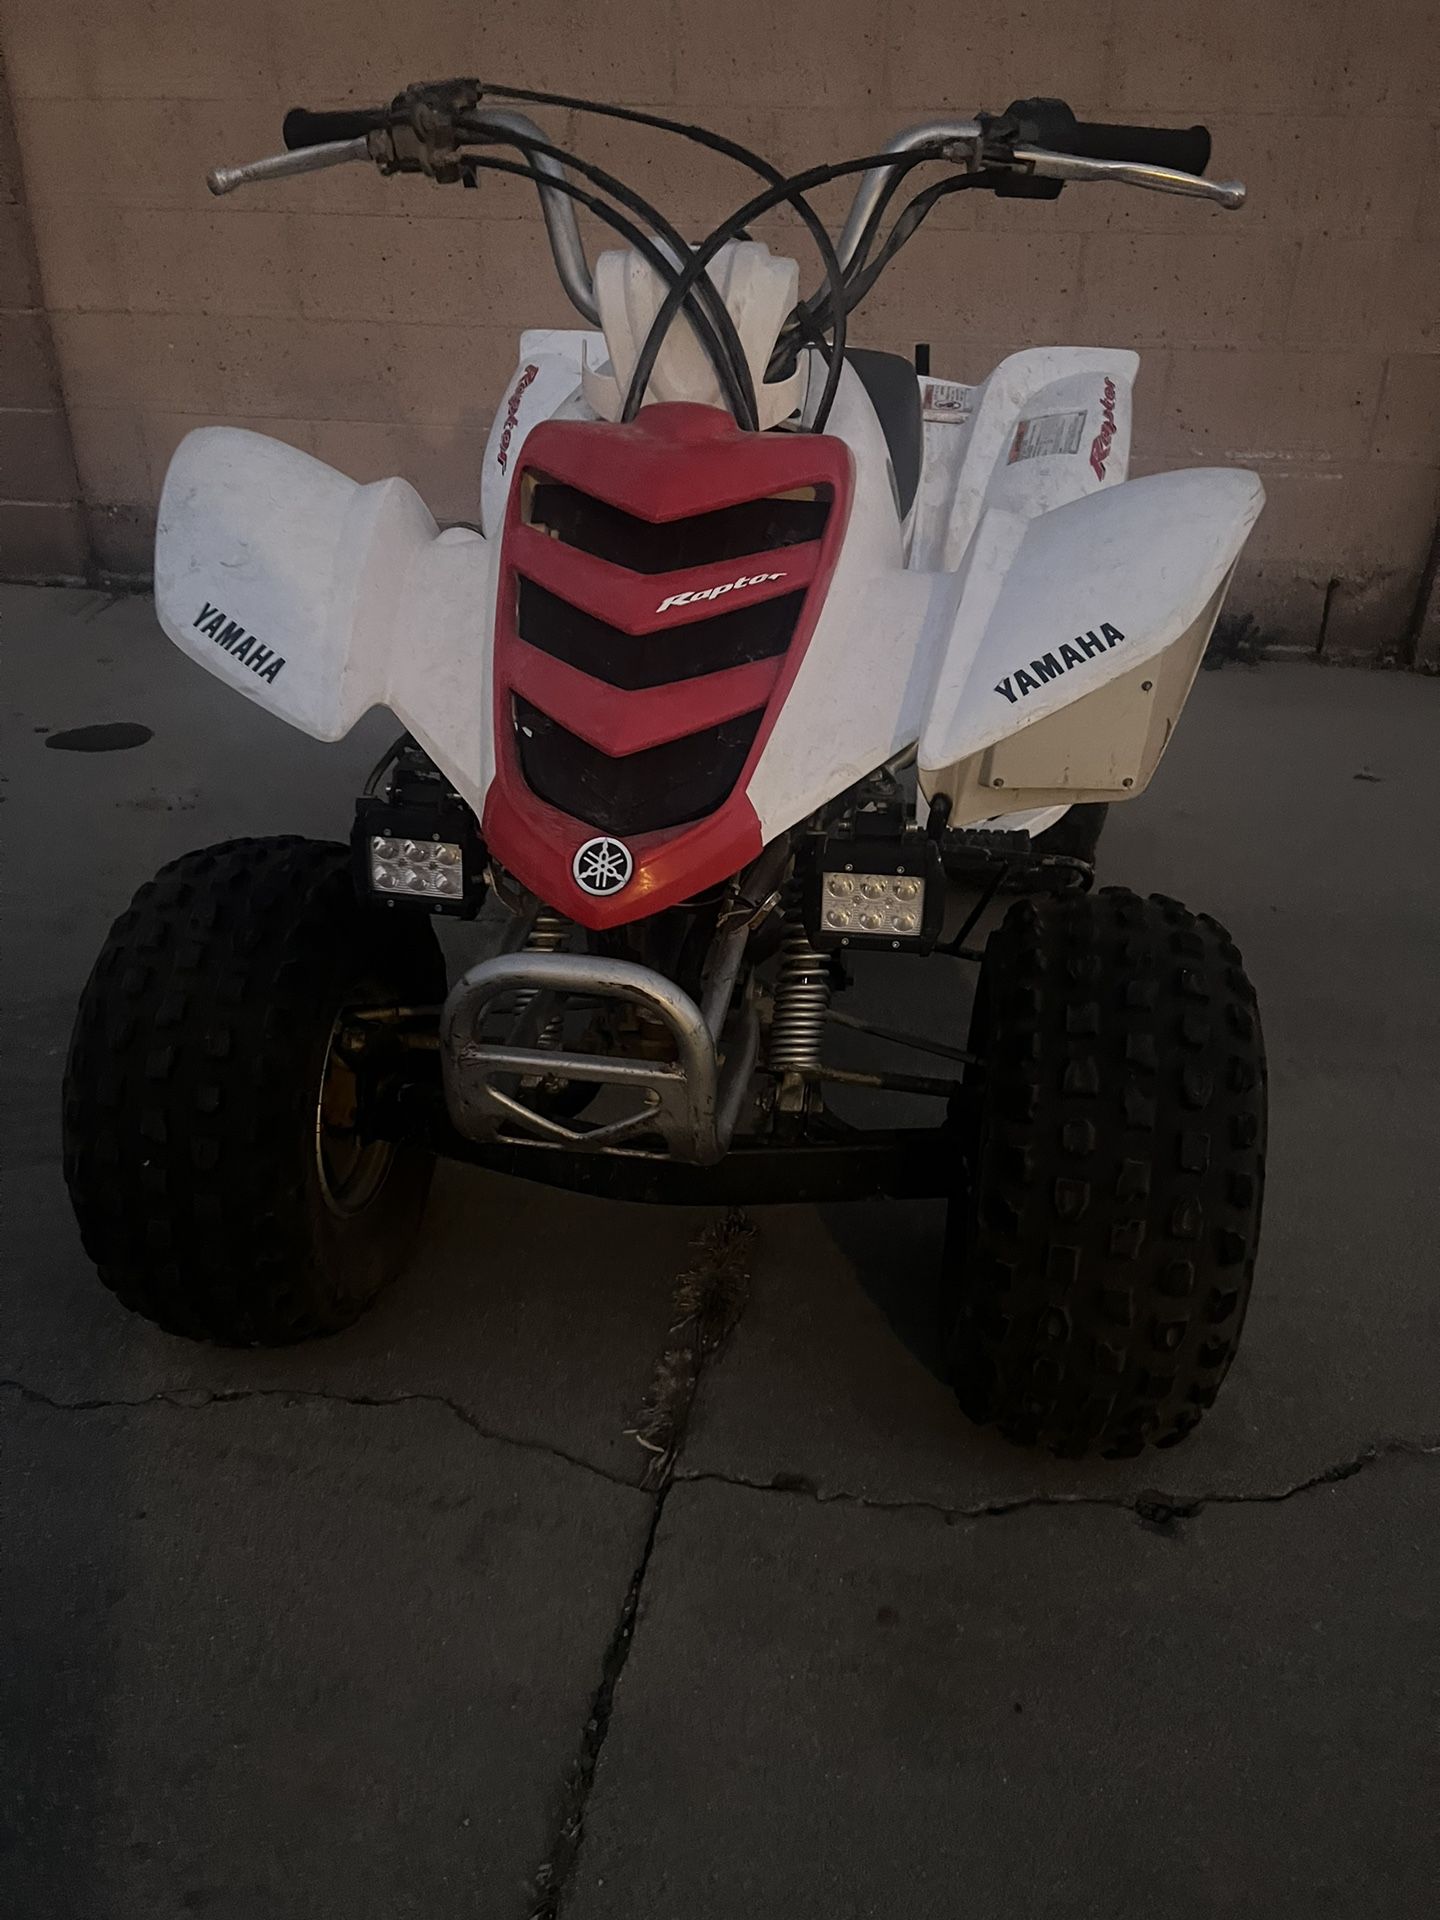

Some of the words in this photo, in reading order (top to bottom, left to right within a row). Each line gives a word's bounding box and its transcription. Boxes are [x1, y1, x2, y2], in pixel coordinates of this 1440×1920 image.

[497, 364, 539, 477] Raptor
[1089, 376, 1118, 482] Raptor
[656, 572, 787, 613] Raptor
[193, 602, 286, 684] YAMAHA
[994, 622, 1125, 704] YAMAHA
